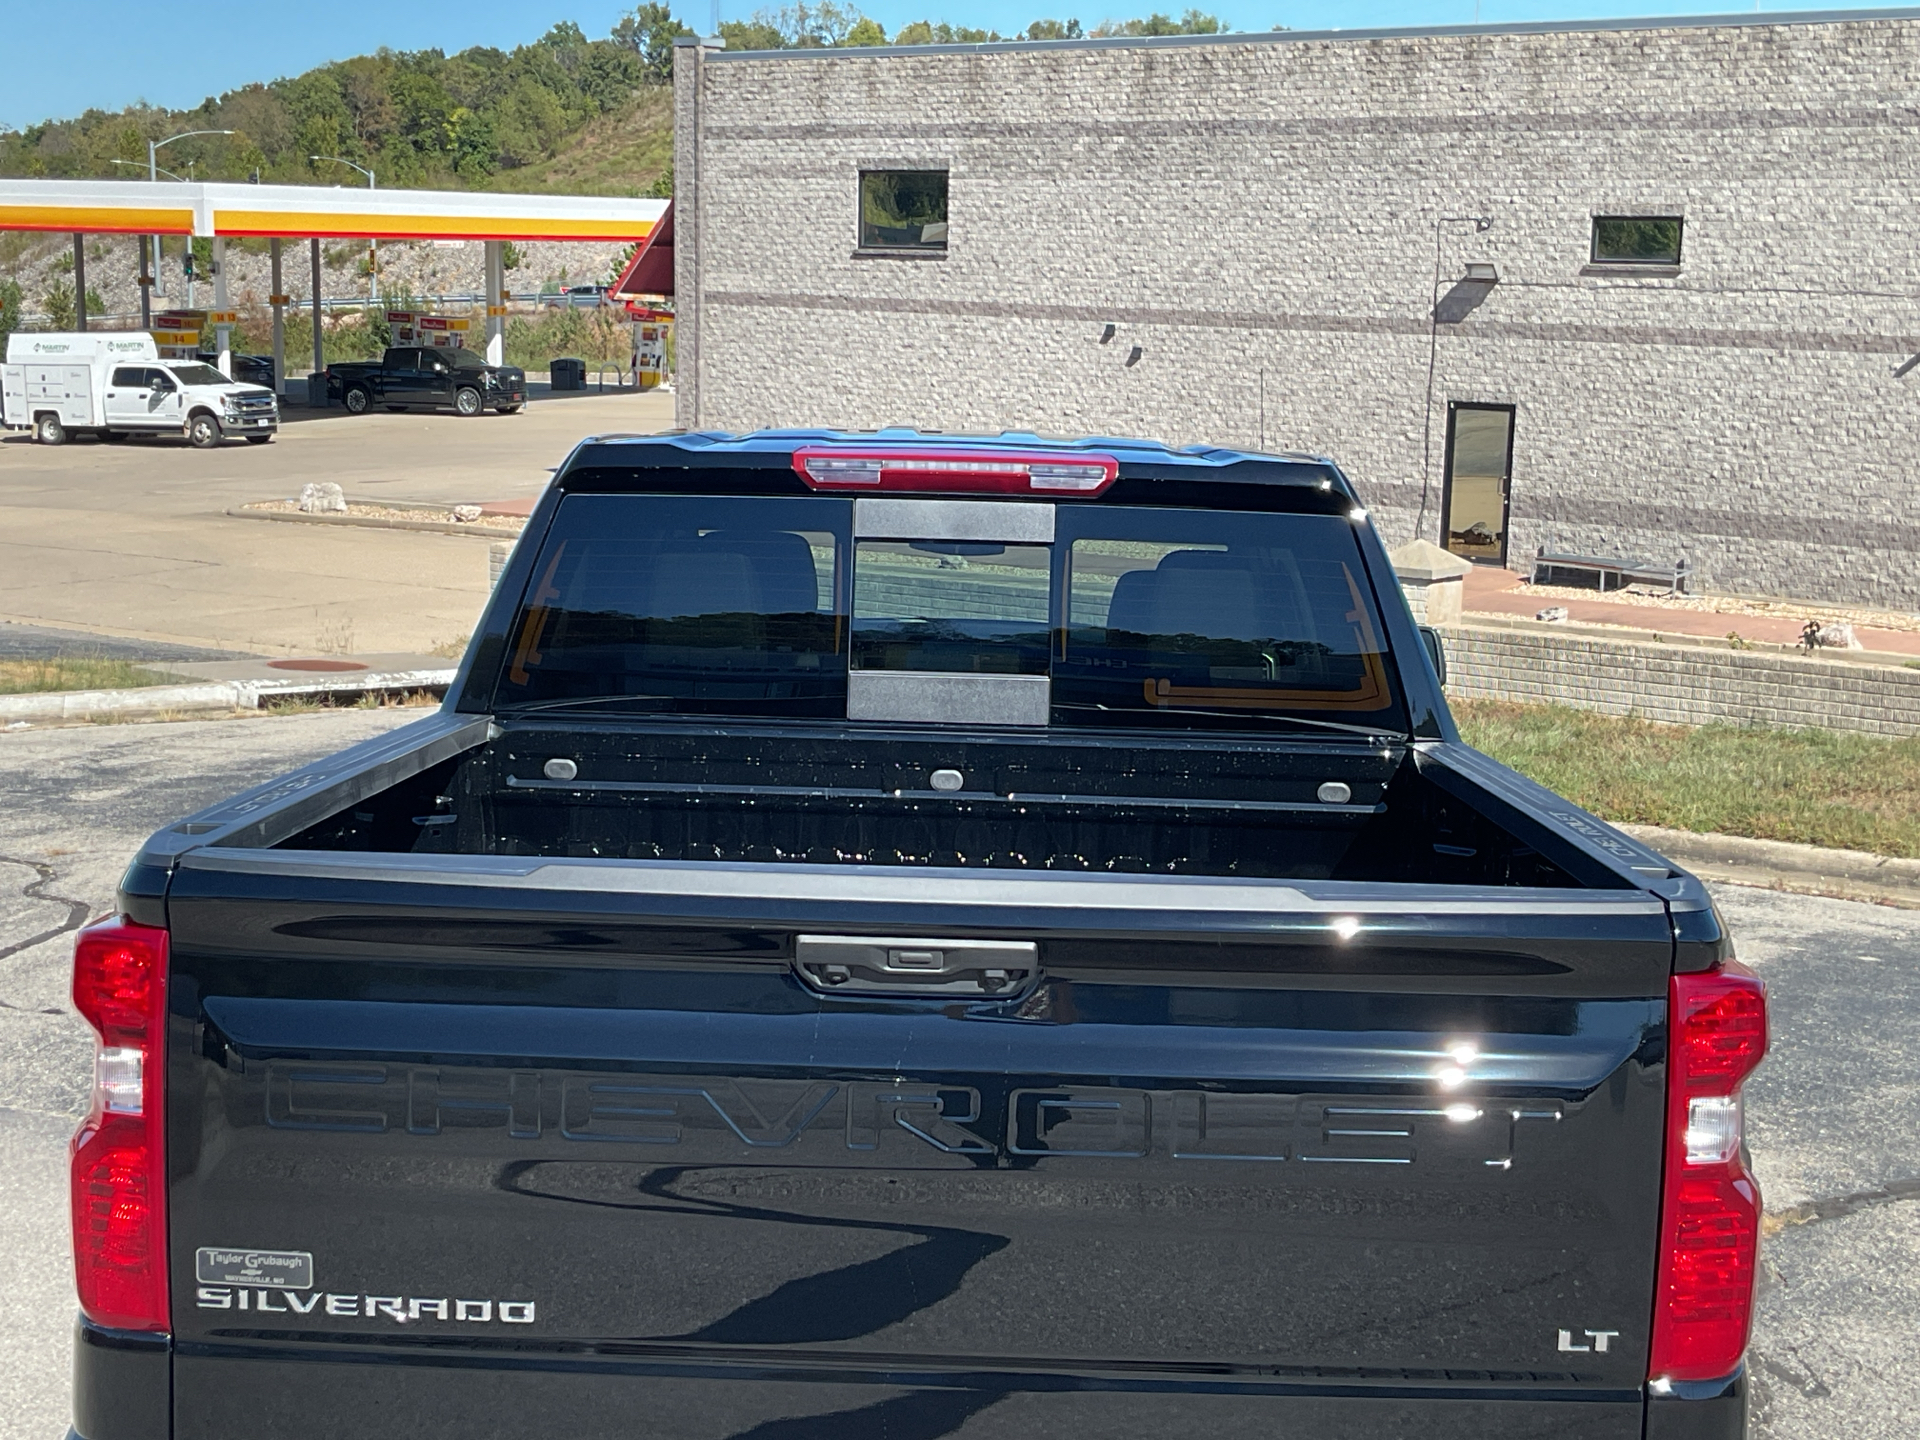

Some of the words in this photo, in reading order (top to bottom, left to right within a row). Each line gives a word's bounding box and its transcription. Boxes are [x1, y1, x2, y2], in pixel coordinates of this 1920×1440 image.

[173, 335, 185, 344] 14
[266, 1060, 1563, 1167] CHEVROLET
[206, 1251, 244, 1266] Taylor
[245, 1253, 302, 1269] Grubaugh
[196, 1287, 536, 1324] SILVERADO
[1557, 1328, 1620, 1352] LT
